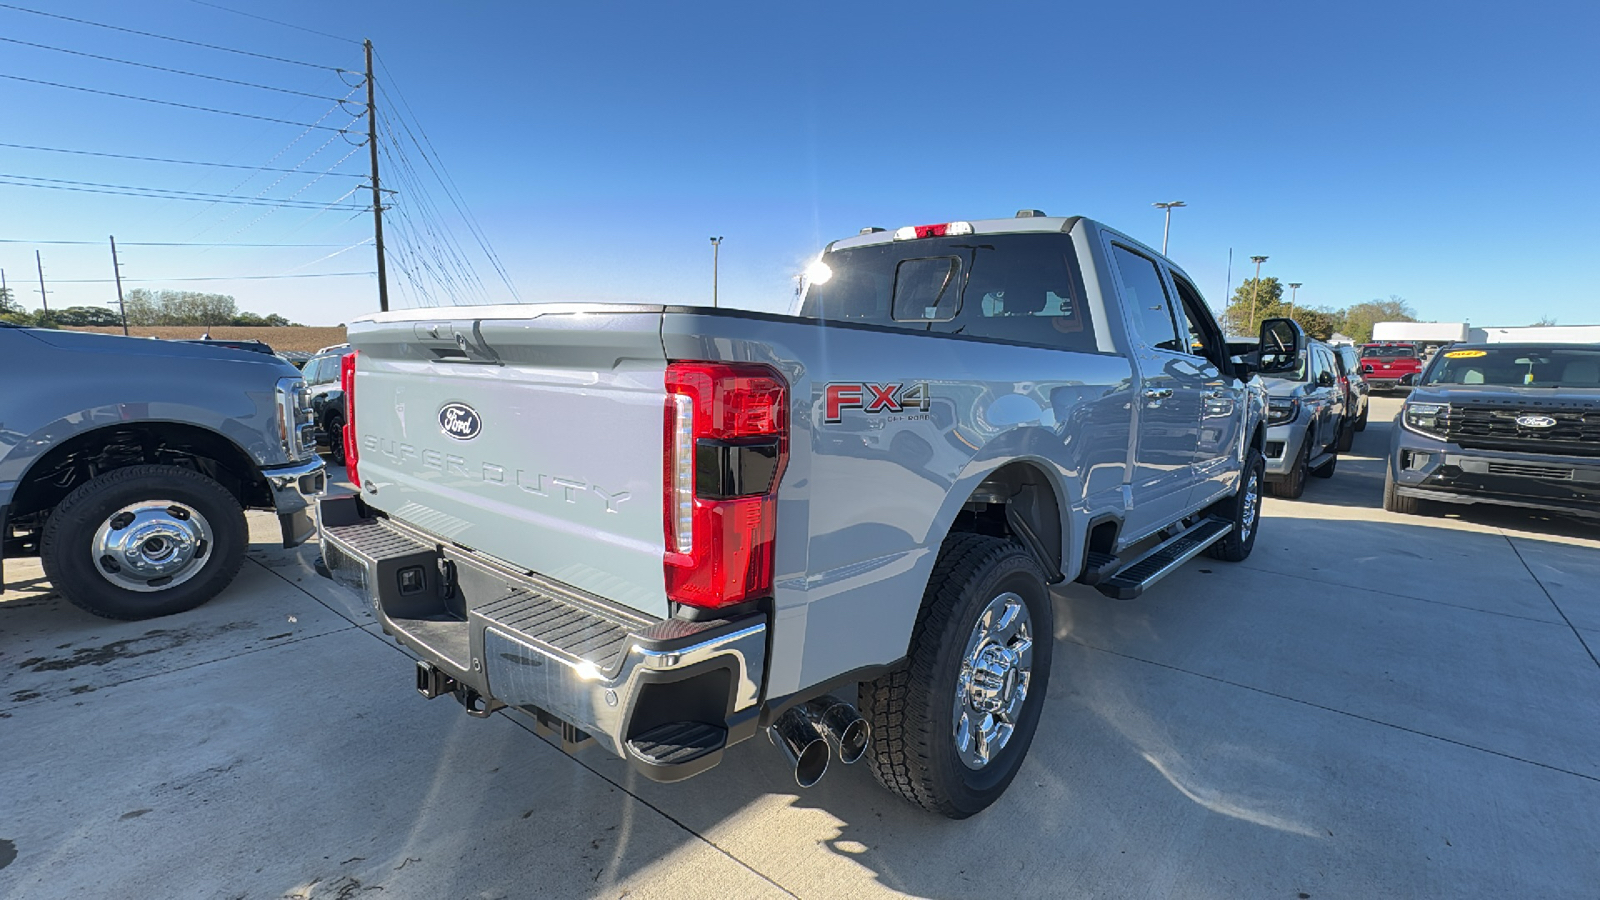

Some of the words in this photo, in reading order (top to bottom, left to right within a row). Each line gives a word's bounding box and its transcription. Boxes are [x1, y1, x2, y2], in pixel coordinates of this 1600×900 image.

[442, 405, 474, 436] Ford
[823, 382, 931, 424] FX4
[364, 434, 470, 478] SUPER
[481, 461, 632, 514] DUTY
